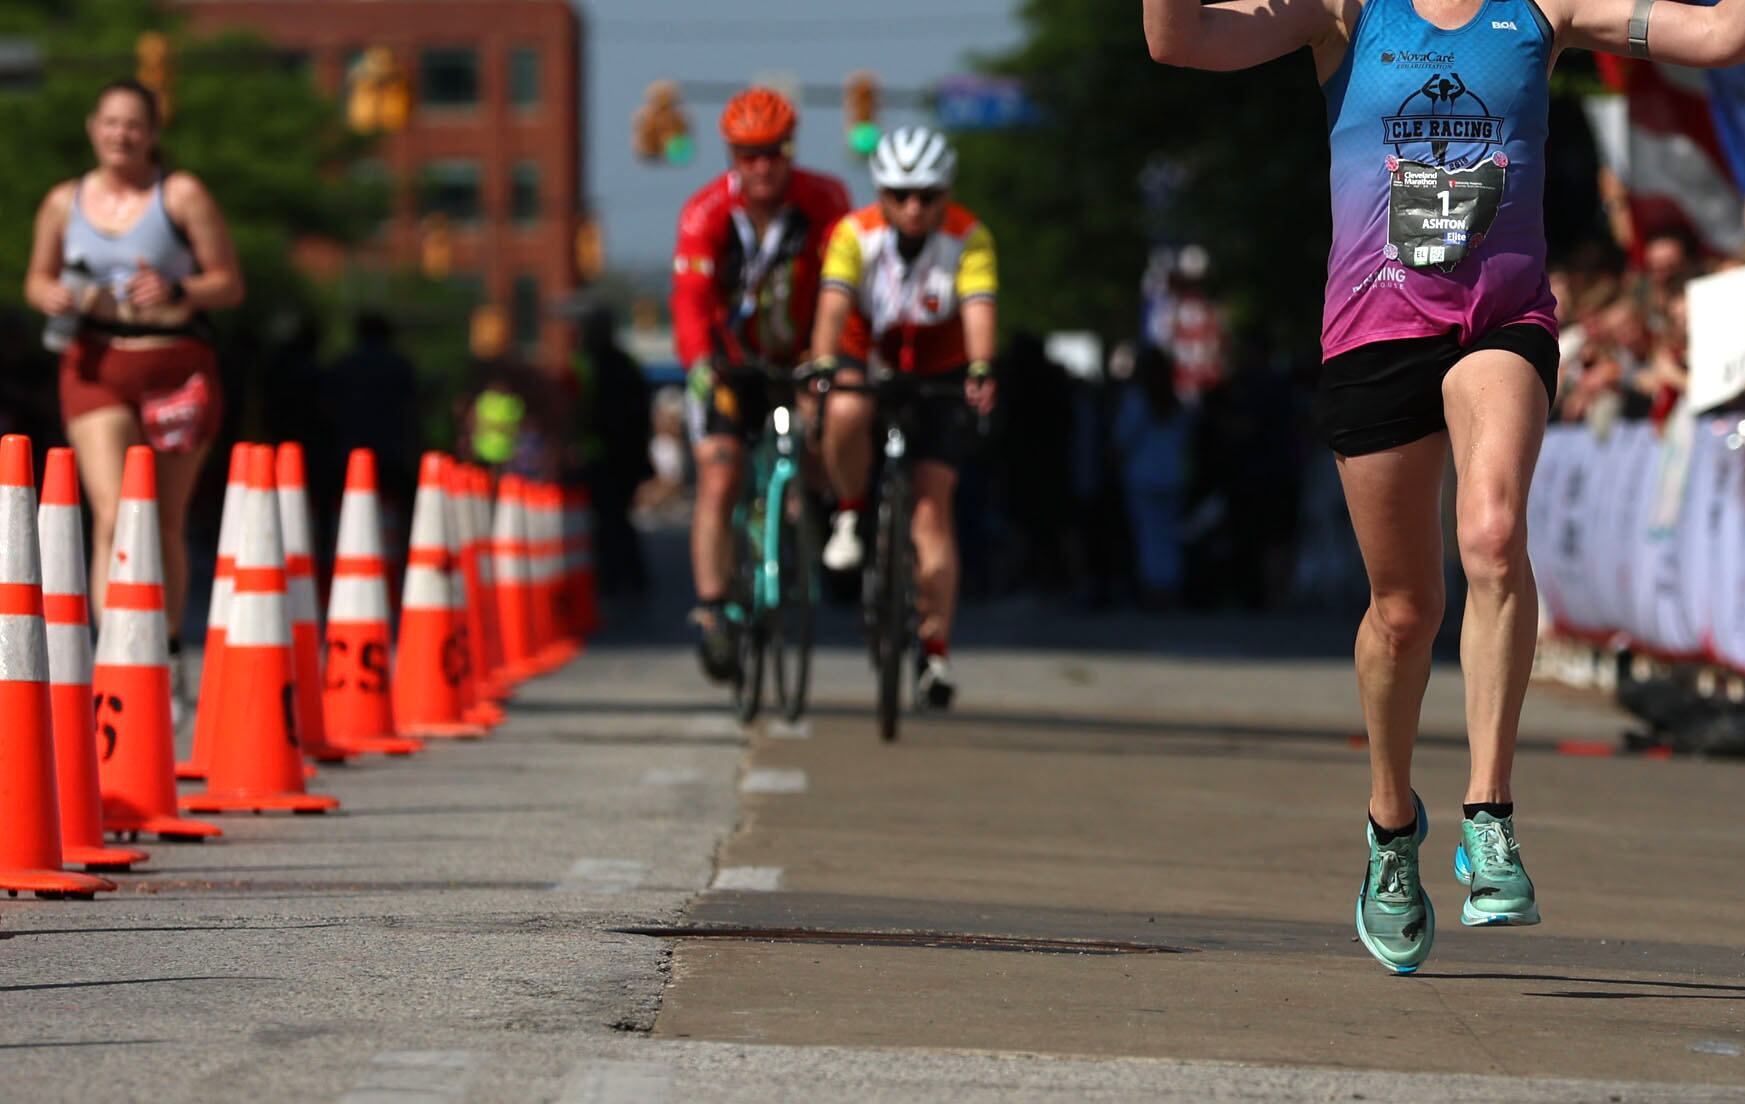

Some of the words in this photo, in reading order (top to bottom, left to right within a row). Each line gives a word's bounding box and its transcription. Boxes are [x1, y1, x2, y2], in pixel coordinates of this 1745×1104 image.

[1491, 21, 1517, 30] BOA
[1397, 50, 1454, 63] NovaCare
[1392, 120, 1423, 138] CLE
[1429, 120, 1493, 138] RACING
[1404, 171, 1438, 179] Cleveland
[1437, 191, 1450, 216] 1
[1422, 218, 1467, 230] ASHTON
[1447, 232, 1467, 242] Elite
